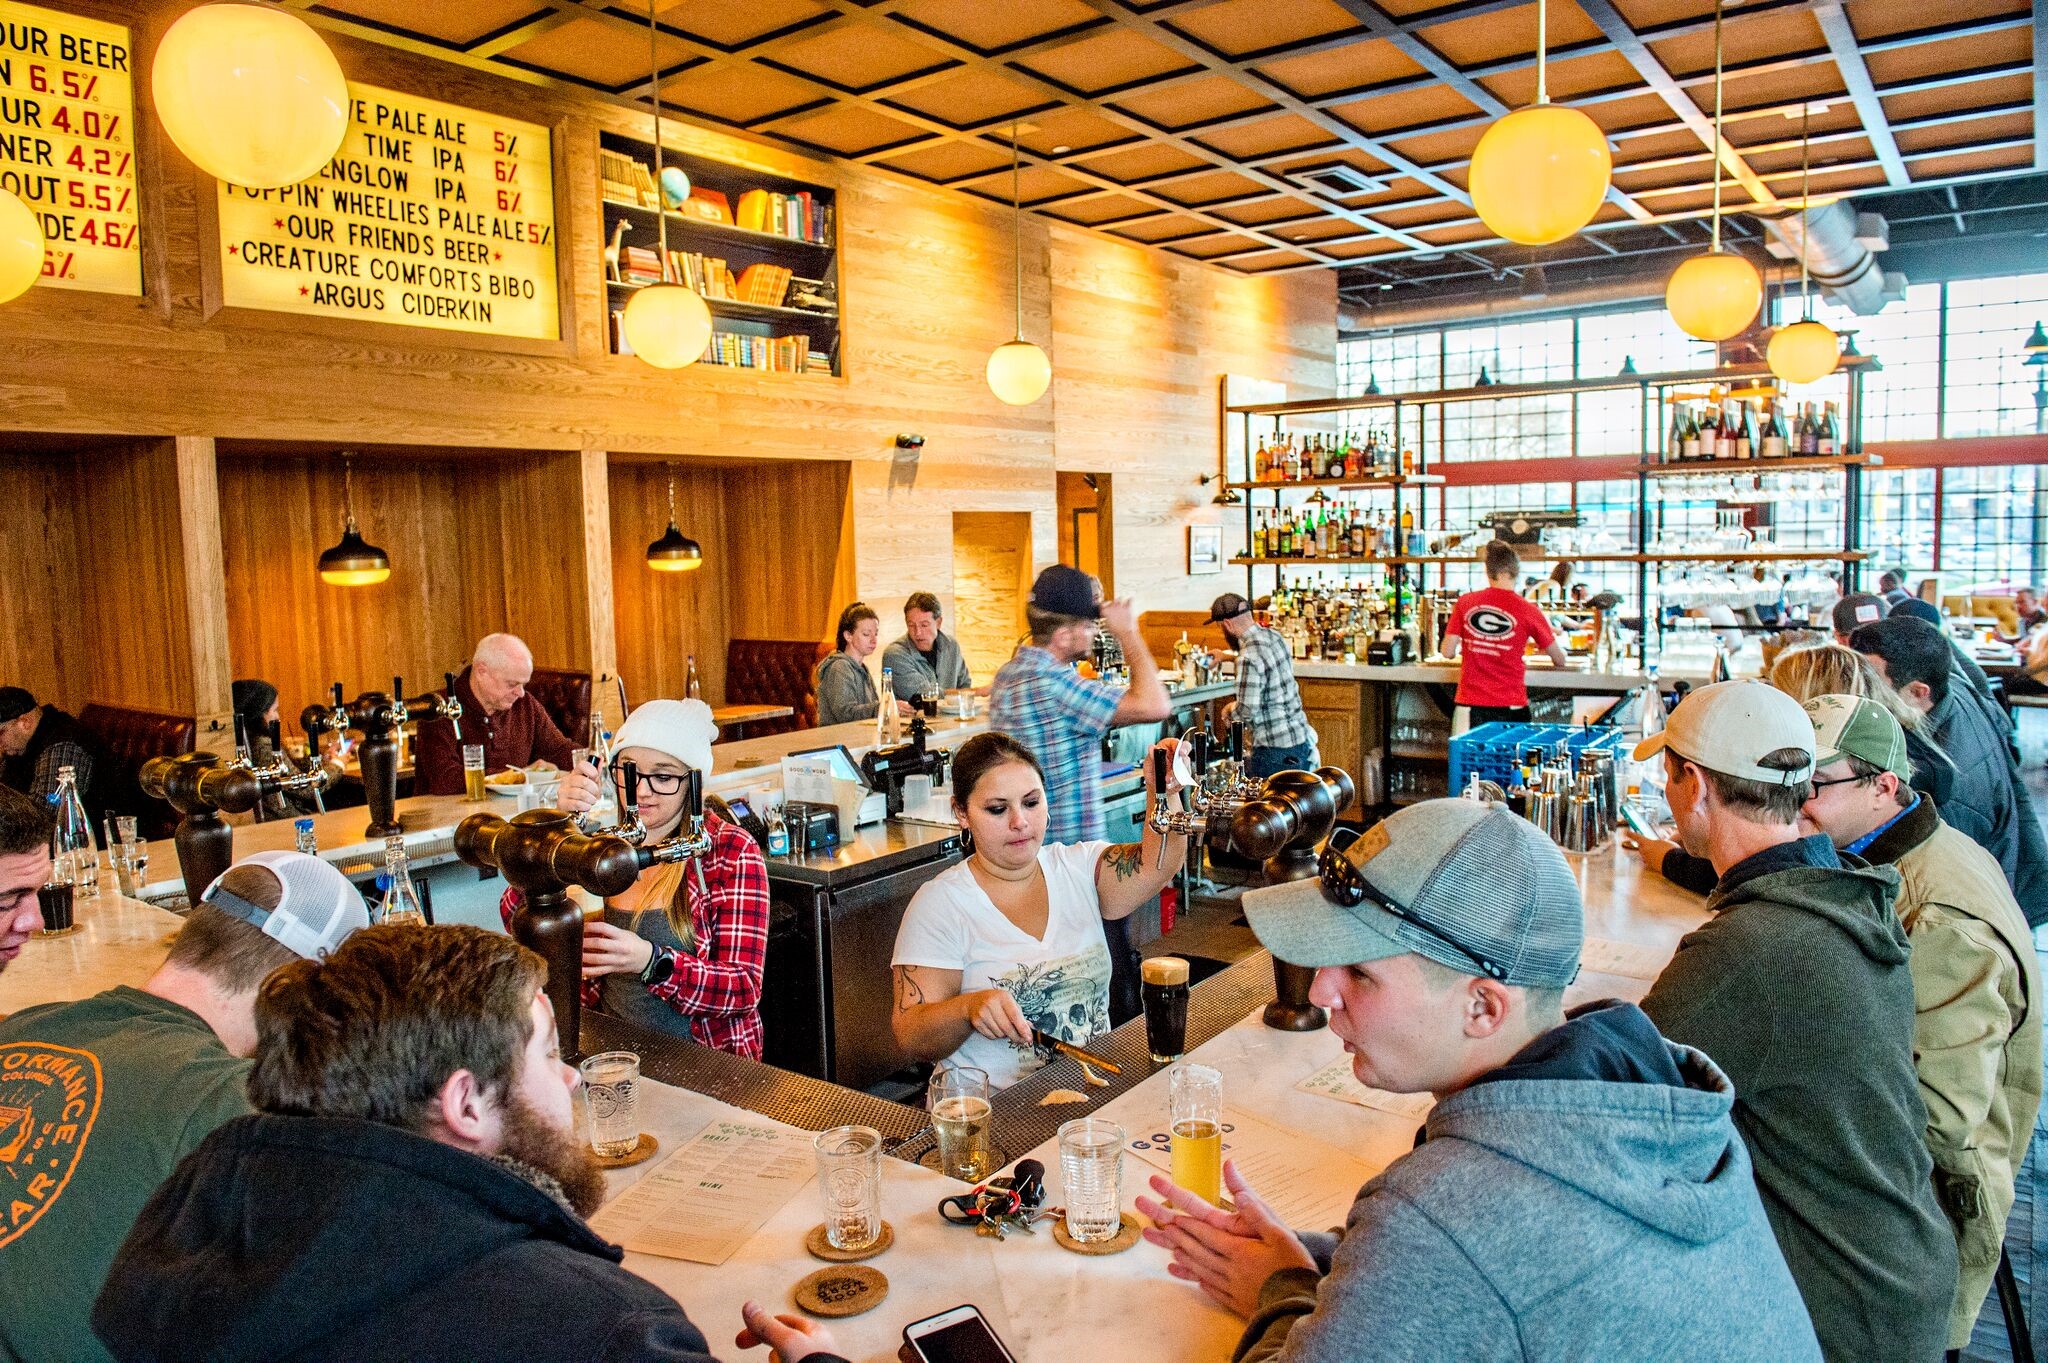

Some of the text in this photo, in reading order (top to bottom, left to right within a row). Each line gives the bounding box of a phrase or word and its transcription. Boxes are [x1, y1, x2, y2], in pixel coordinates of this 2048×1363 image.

[0, 21, 128, 72] UR BEER
[29, 64, 99, 102] 6.5%
[2, 96, 120, 142] UR 4.0%
[376, 104, 427, 135] PALE
[434, 118, 467, 145] ALE
[494, 131, 519, 158] 5%
[66, 144, 132, 179] 4.2%
[364, 132, 518, 184] TIME IPA 6%
[2, 171, 131, 214] OUT 5.5%
[435, 177, 466, 203] IPA
[497, 190, 522, 213] 6%
[80, 218, 139, 251] 4.6%
[288, 214, 489, 265] OUR FRIENDS BEER
[333, 190, 429, 226] WHEELIES
[439, 208, 486, 236] PALE
[492, 218, 524, 242] ALE
[528, 223, 553, 247] 5%
[242, 241, 535, 299] CREATURE COMFORTS BIBO
[313, 282, 492, 323] ARGUS CIDERKIN
[0, 1052, 87, 1146] ORMANCE
